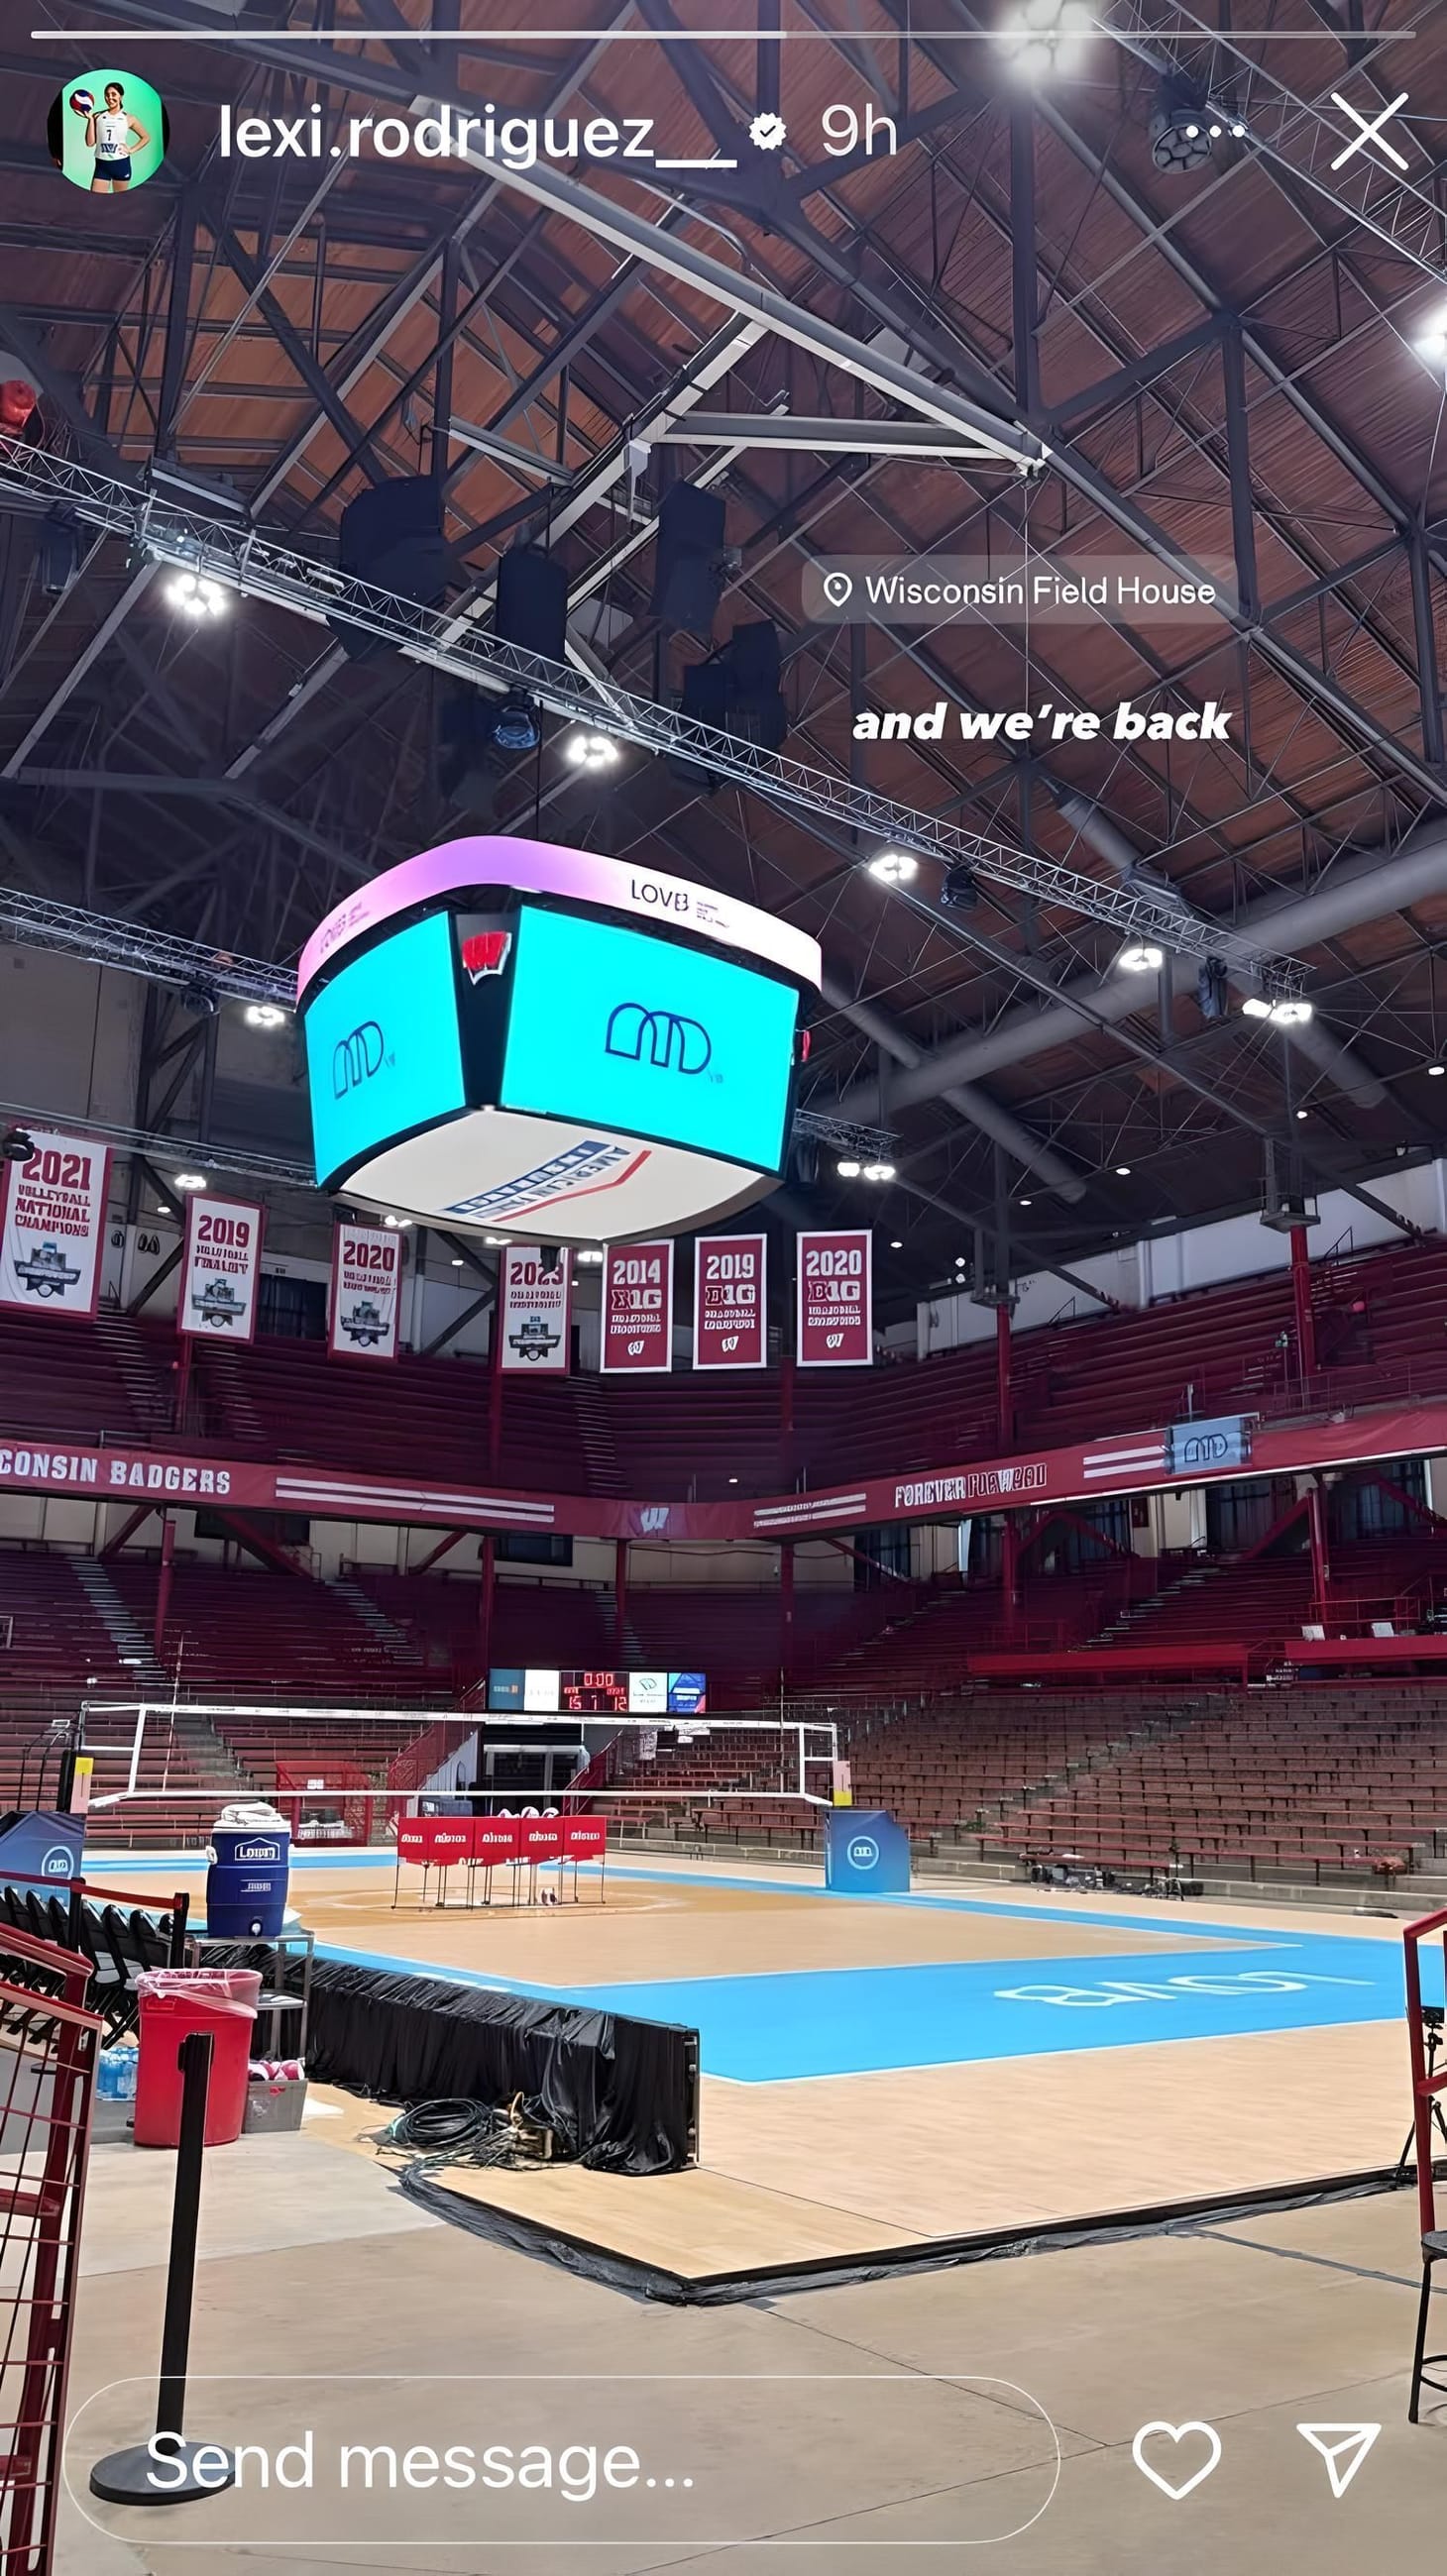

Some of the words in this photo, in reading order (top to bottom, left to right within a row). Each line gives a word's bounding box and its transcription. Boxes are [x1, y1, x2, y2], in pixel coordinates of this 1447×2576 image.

[22, 1147, 91, 1191] 2021
[15, 1197, 91, 1224] NATIONAL
[198, 1215, 250, 1248] 2019
[343, 1239, 395, 1272] 2020
[706, 1253, 755, 1280] 2019
[806, 1249, 862, 1276] 2020
[612, 1259, 661, 1285] 2014
[110, 1459, 231, 1495] BADGERS
